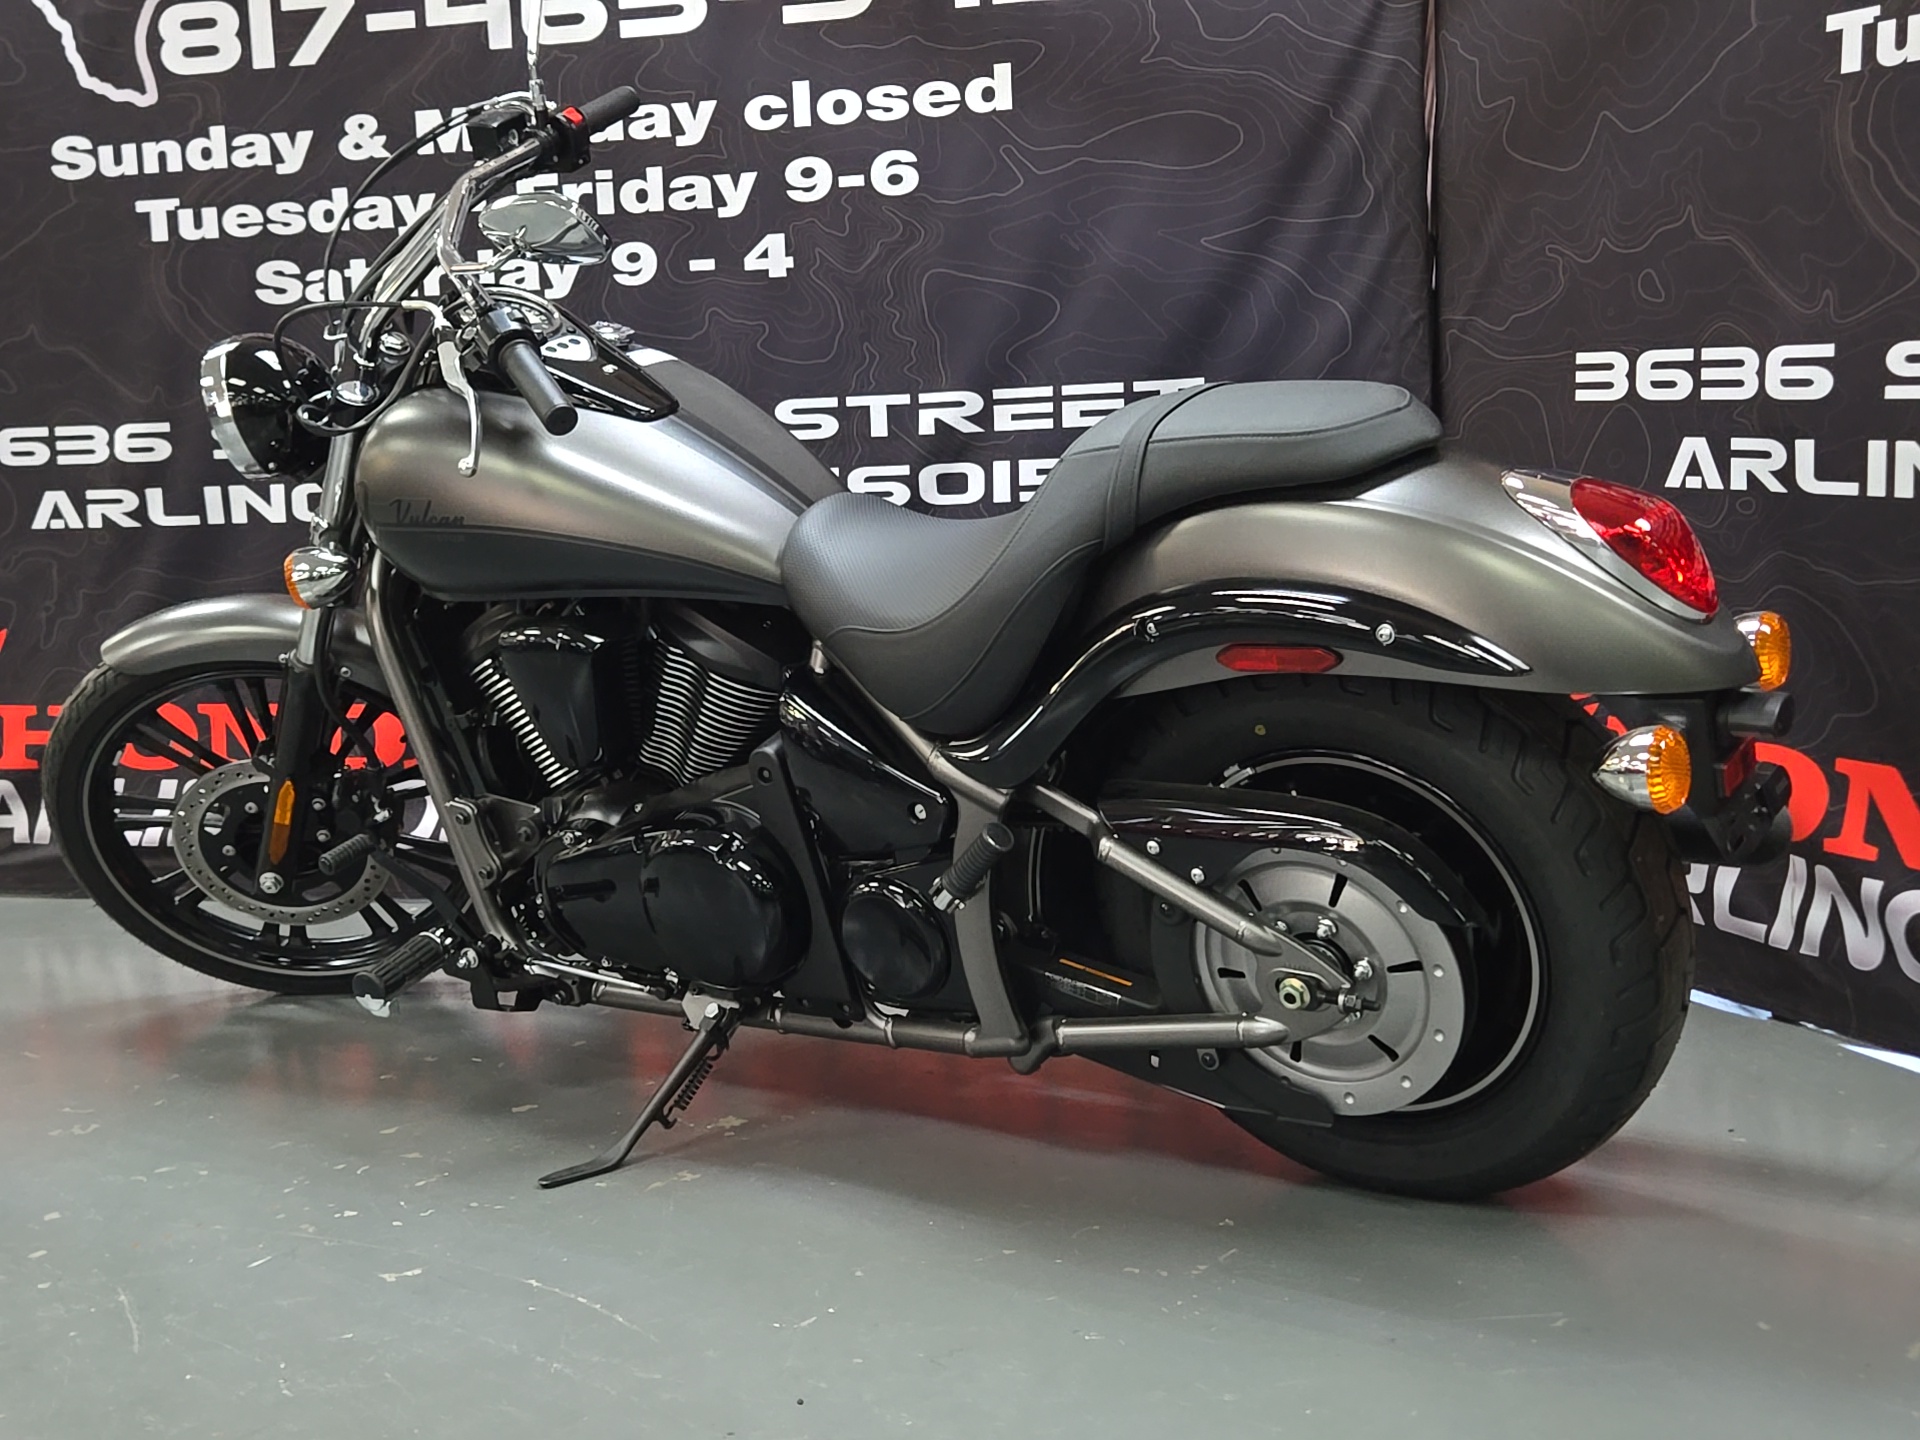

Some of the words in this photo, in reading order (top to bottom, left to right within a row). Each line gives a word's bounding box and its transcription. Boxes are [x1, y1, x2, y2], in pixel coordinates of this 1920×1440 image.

[51, 126, 313, 180] Sunday
[338, 114, 389, 161] &
[744, 62, 1014, 131] closed
[135, 187, 436, 243] Tuesday
[784, 150, 920, 203] 9-6
[611, 241, 658, 287] 9
[743, 233, 795, 279] 4
[1574, 343, 1836, 401] 3636
[389, 498, 465, 526] Vulcan
